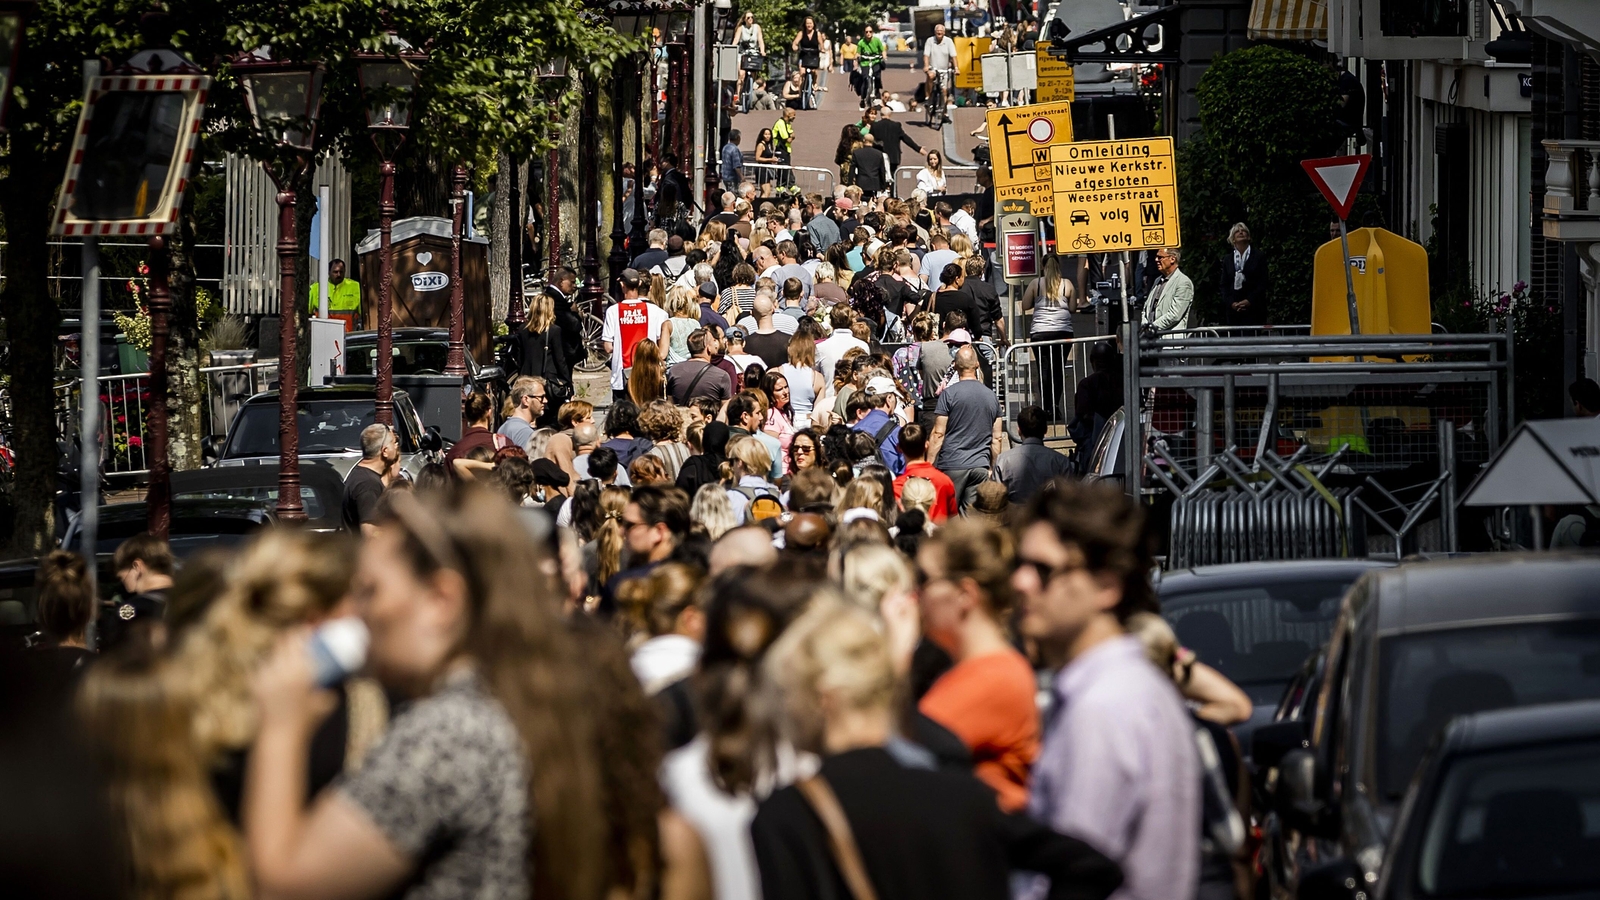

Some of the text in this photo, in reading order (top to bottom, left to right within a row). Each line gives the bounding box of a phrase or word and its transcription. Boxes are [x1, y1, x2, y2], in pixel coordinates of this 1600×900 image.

[1032, 108, 1068, 117] Kerkstraat
[1035, 149, 1047, 162] W
[1069, 144, 1150, 158] Omleiding
[1055, 159, 1167, 176] Nieuwe Kerkstr.
[1000, 184, 1050, 197] uitgezon
[1074, 175, 1149, 192] afgesloten
[1068, 188, 1160, 203] Weesperstraat
[1100, 203, 1161, 224] volg W
[1102, 231, 1132, 246] volg
